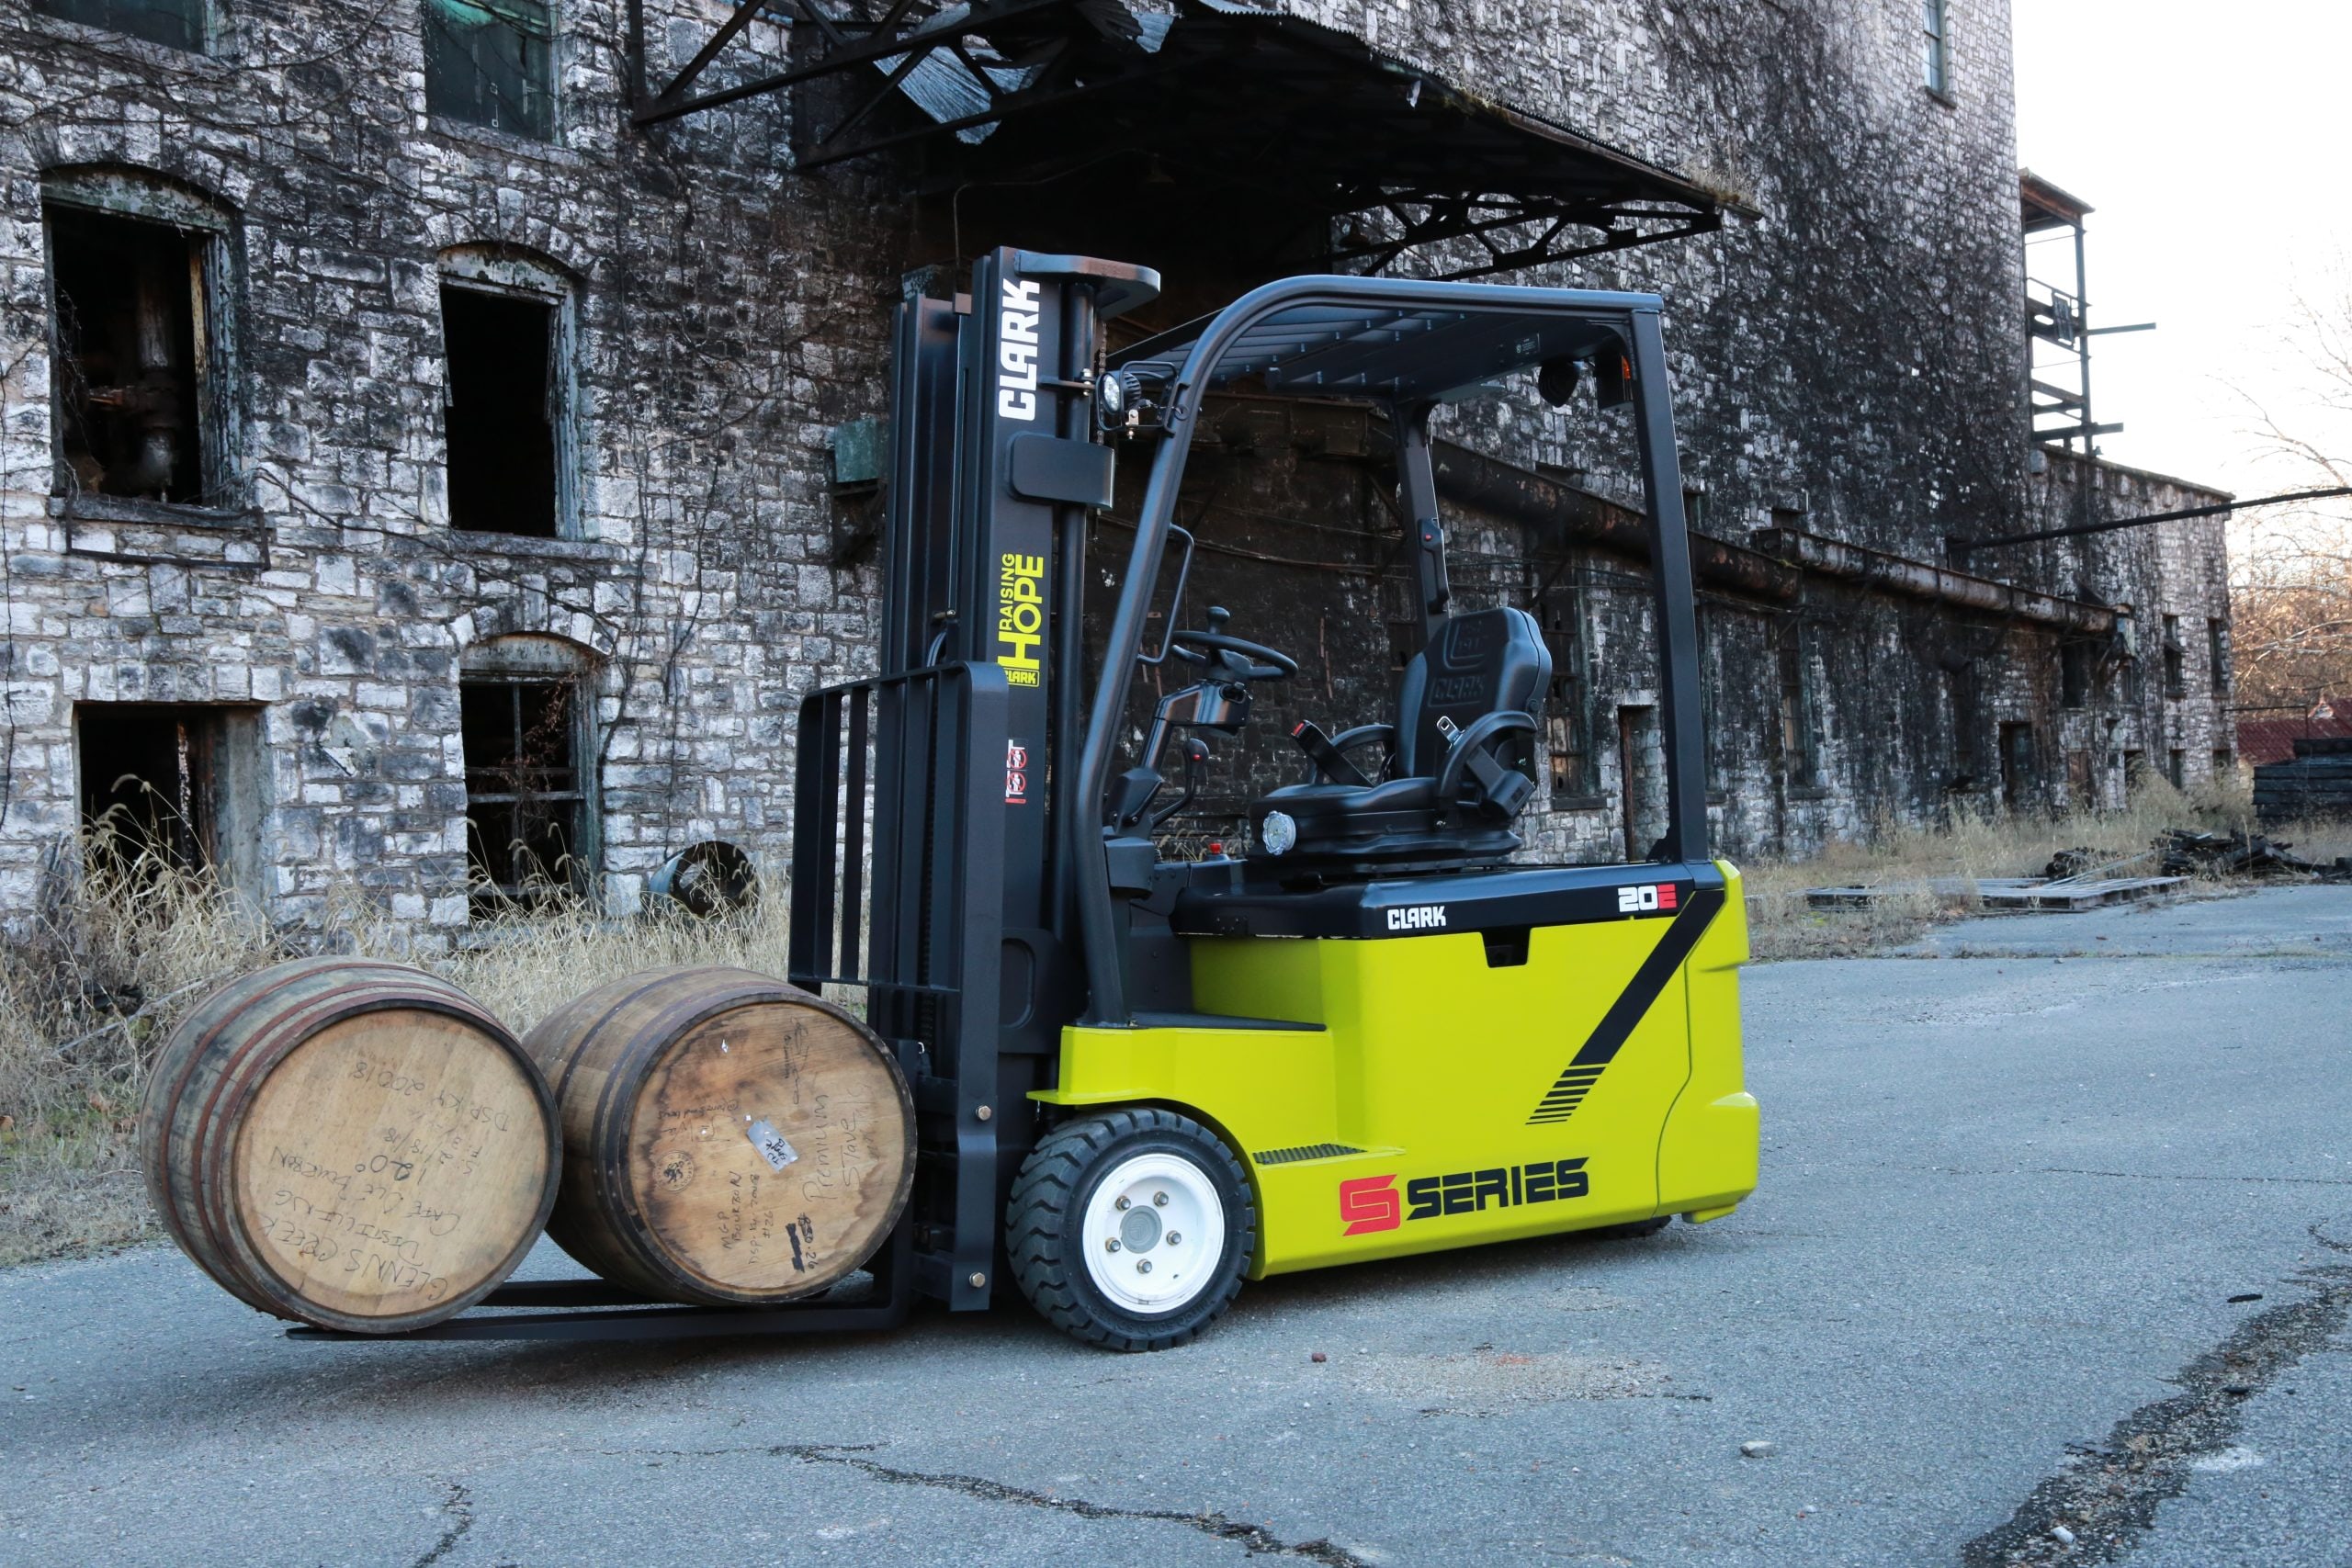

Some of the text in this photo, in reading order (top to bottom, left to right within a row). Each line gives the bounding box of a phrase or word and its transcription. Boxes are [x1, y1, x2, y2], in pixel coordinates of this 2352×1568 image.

[998, 277, 1041, 422] CLARK
[998, 554, 1045, 671] HOPE
[999, 553, 1015, 631] RAISING
[1386, 905, 1447, 931] CLARK
[1617, 884, 1678, 913] 20E
[1340, 1156, 1589, 1235] S SERIES
[257, 1211, 338, 1262] CREEK
